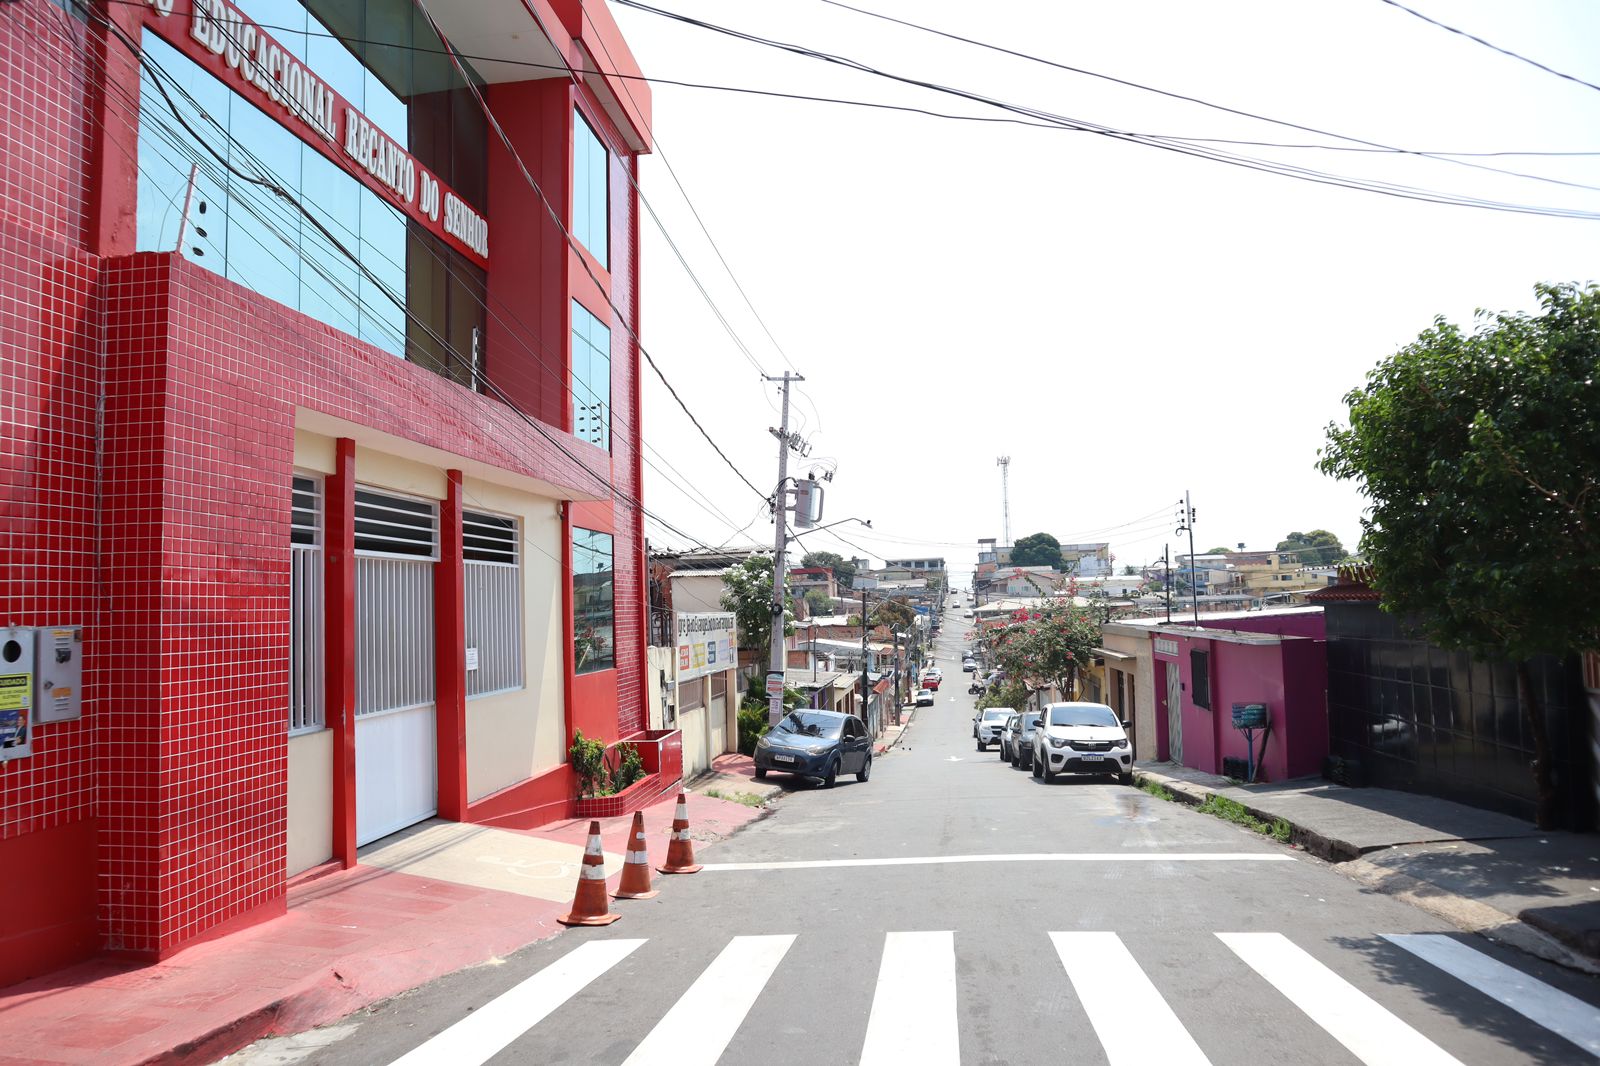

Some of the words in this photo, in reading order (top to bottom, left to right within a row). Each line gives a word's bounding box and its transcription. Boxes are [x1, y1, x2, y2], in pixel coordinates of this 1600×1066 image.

[190, 0, 336, 142] EDUCACIONAL
[343, 107, 415, 203] RECANTO
[419, 170, 439, 222] DO
[443, 191, 489, 259] SENHOR
